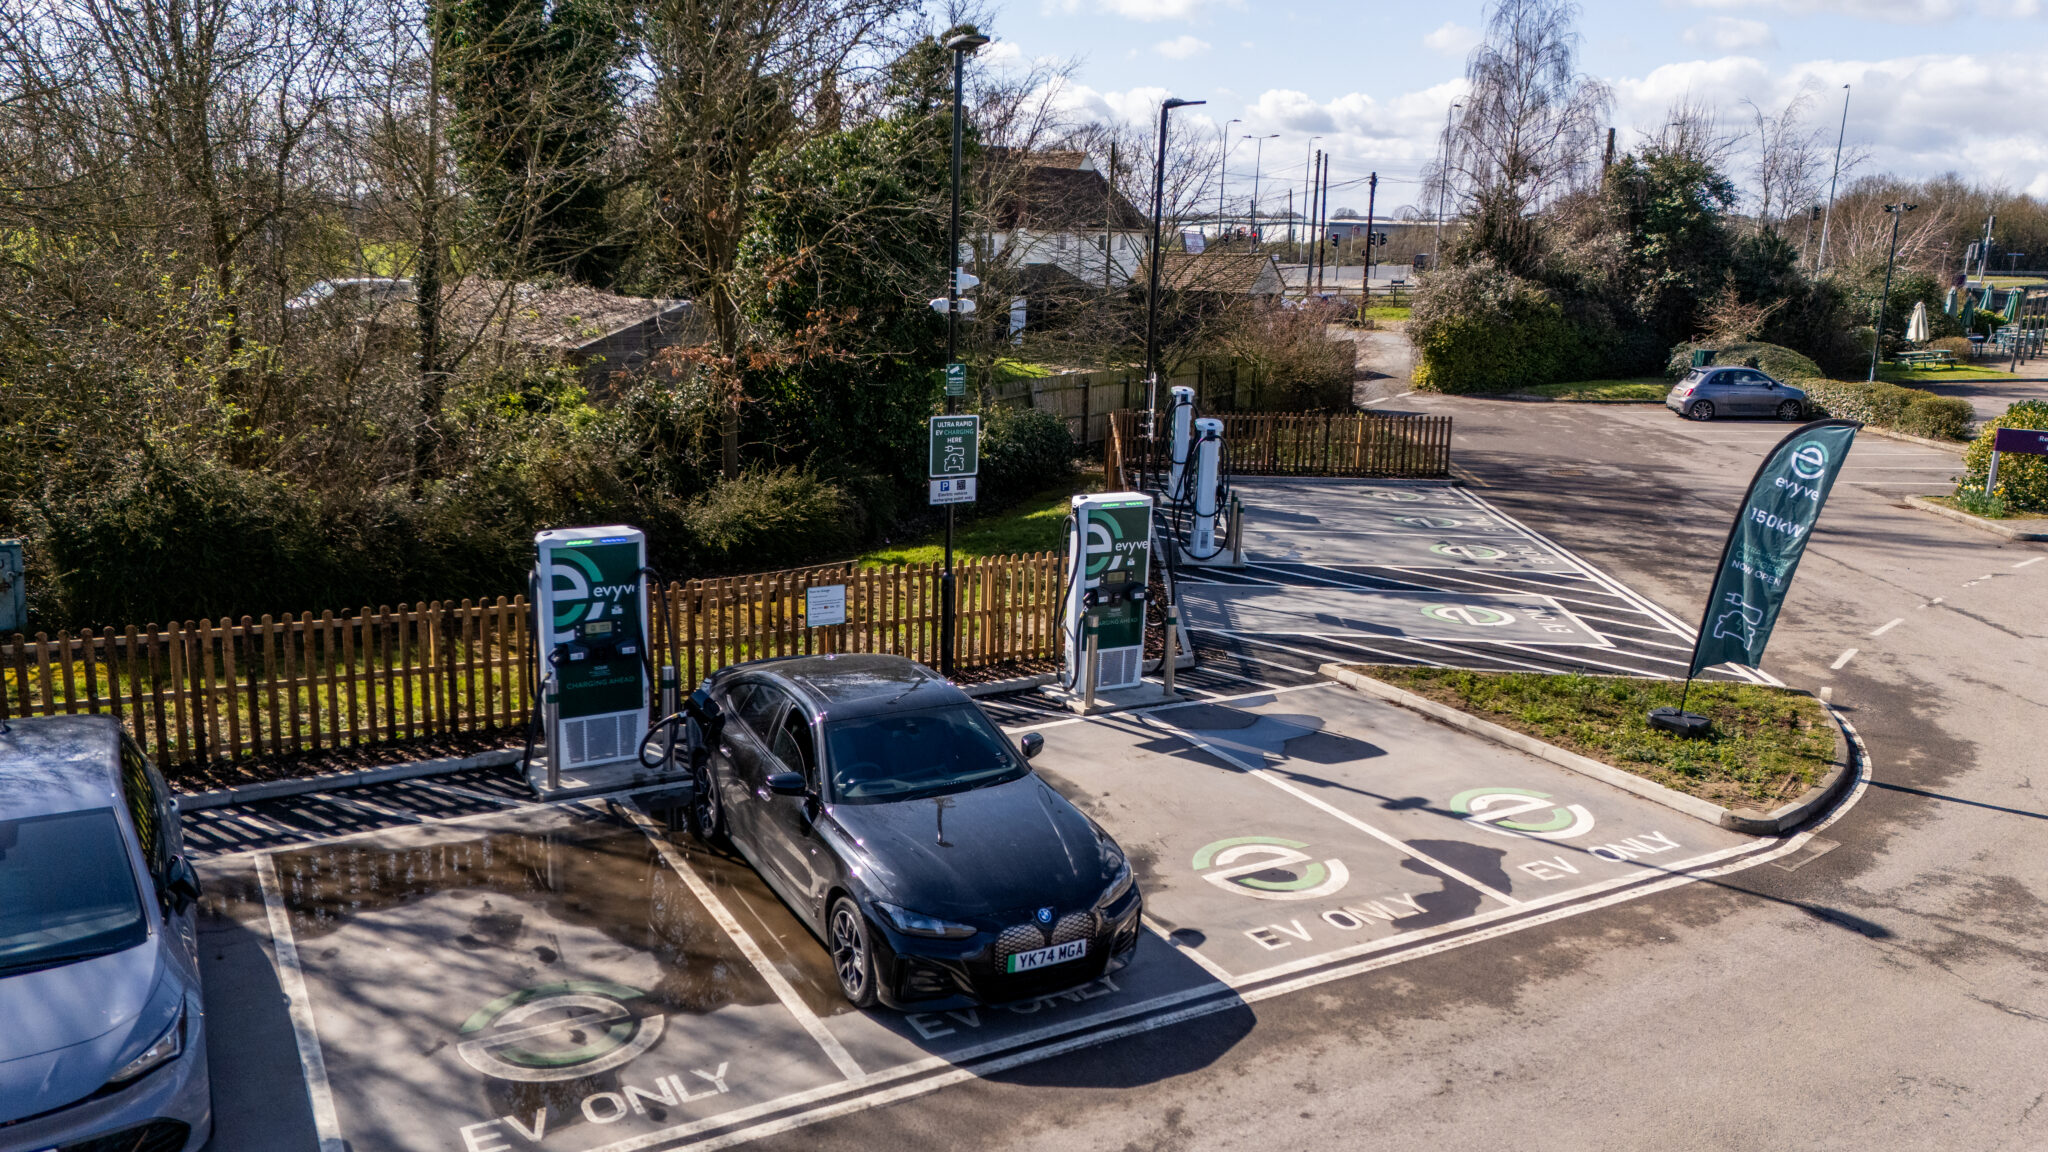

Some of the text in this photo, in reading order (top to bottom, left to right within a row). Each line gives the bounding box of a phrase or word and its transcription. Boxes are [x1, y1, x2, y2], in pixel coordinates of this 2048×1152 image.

[943, 428, 974, 436] CHARGING
[942, 482, 949, 491] P
[1775, 477, 1819, 501] evyve
[1750, 507, 1805, 538] 150kW
[1115, 540, 1149, 556] evyve
[1731, 560, 1781, 587] NOW OPEN
[1517, 830, 1680, 881] EV ONLY
[1243, 893, 1429, 951] EV ONLY
[1020, 942, 1084, 968] YK74 MGA
[905, 1009, 981, 1040] EV
[460, 1061, 730, 1152] EV ONLY
